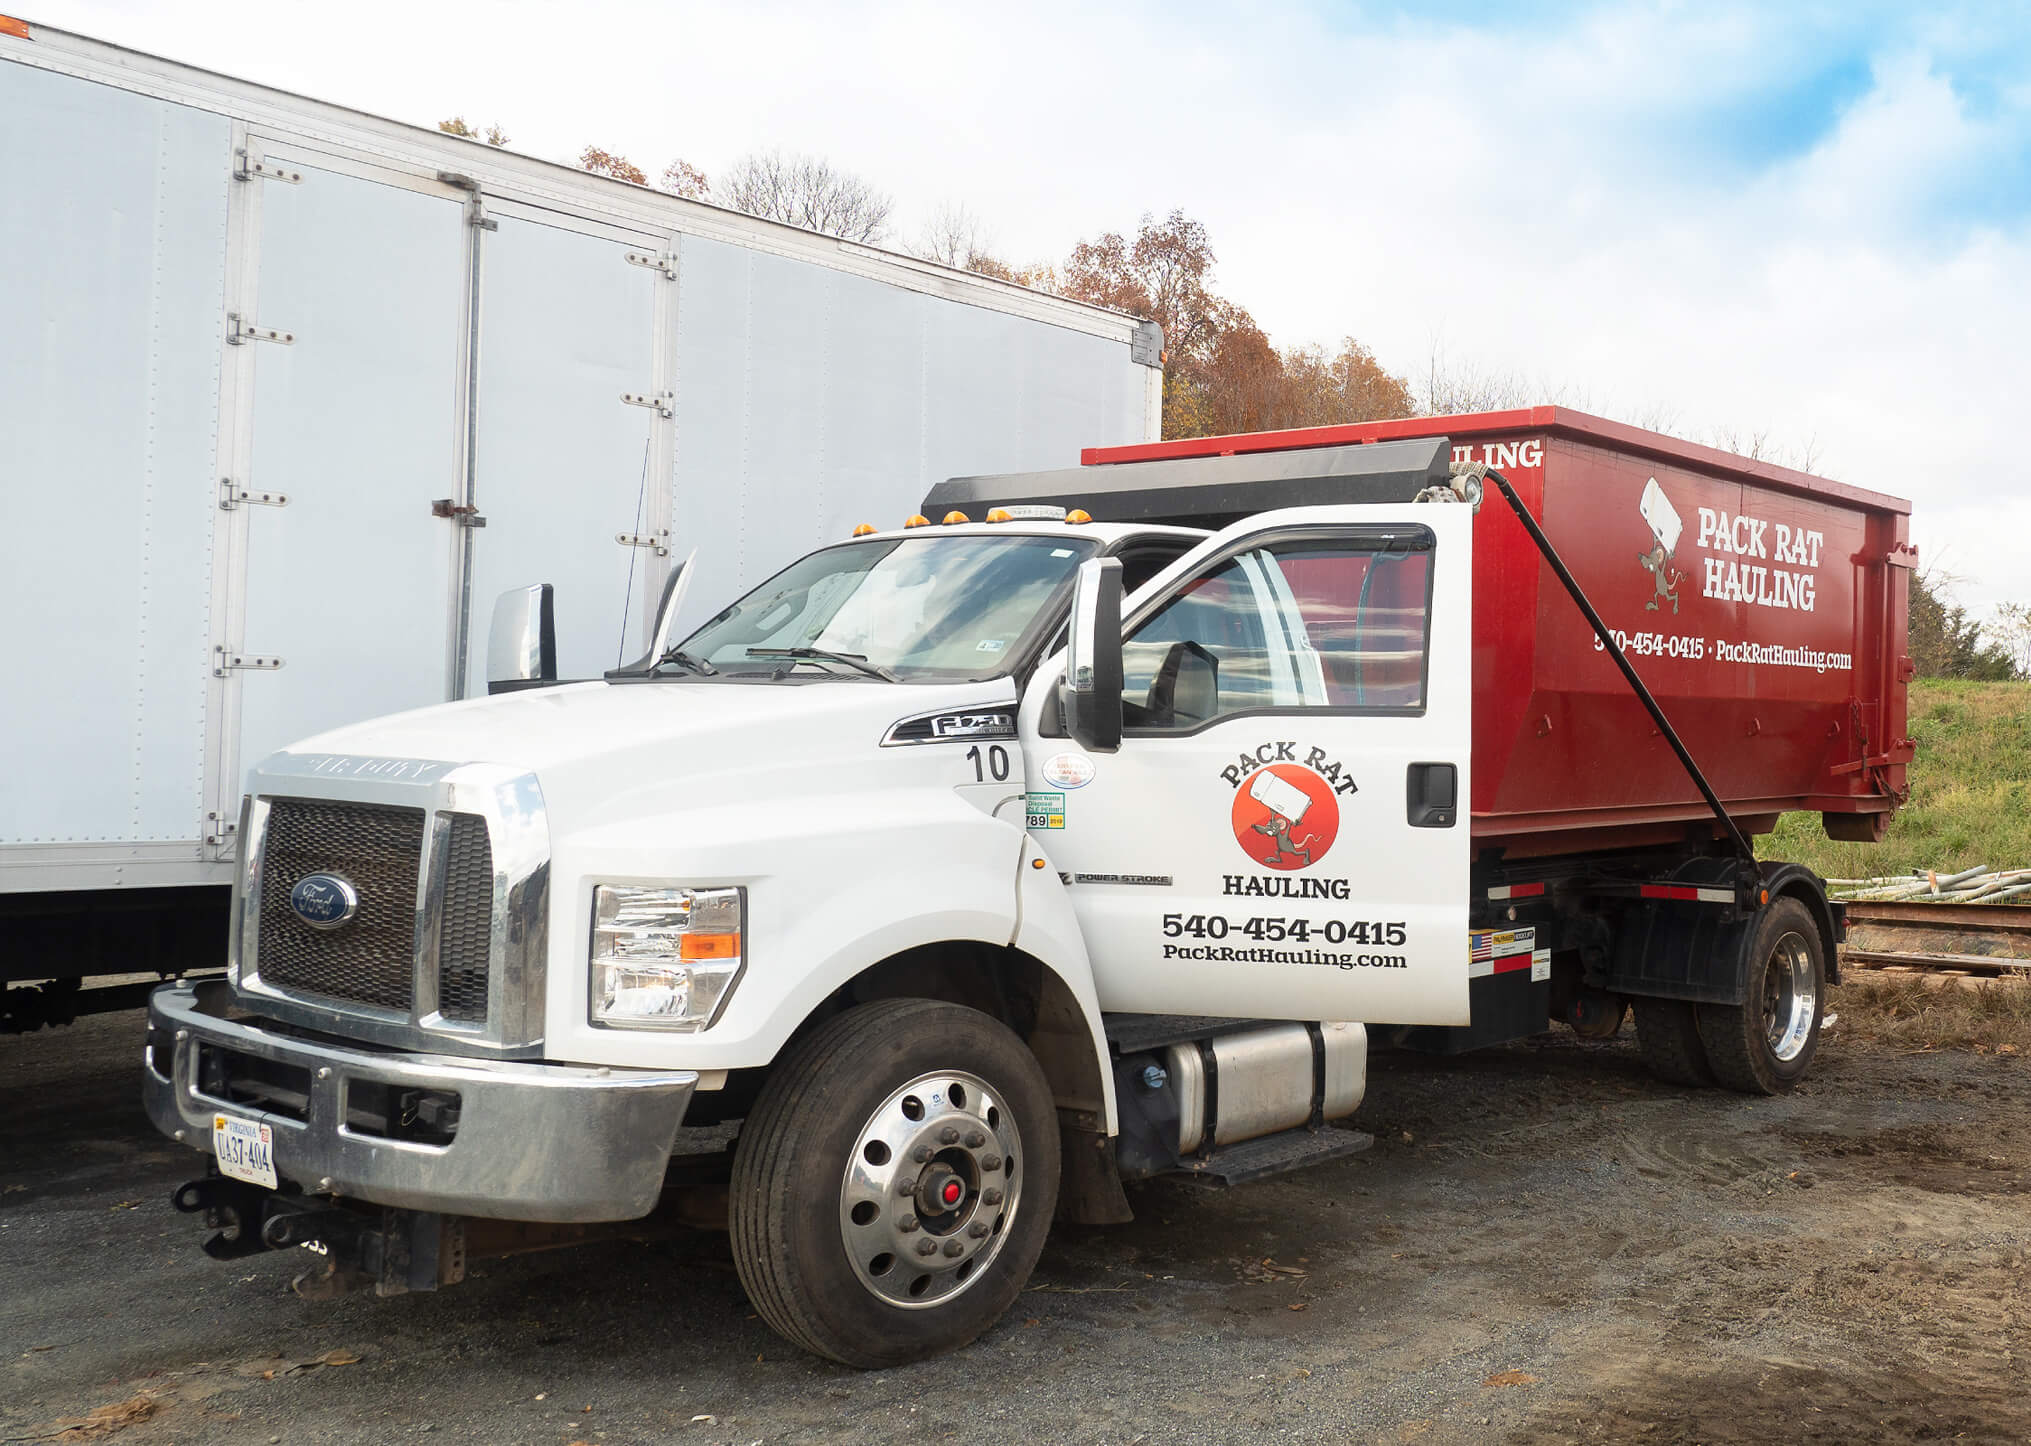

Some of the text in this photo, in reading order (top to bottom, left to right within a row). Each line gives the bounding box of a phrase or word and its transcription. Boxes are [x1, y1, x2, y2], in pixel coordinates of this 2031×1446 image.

[1697, 507, 1824, 568] PACK RAT
[1703, 557, 1816, 612] HAULING
[1716, 639, 1853, 674] PackRatHauling.com
[966, 745, 1010, 782] 10
[1220, 741, 1359, 796] PACK RAT
[1078, 874, 1169, 883] POWER STROKE
[1222, 875, 1351, 900] HAULING
[299, 883, 335, 915] Ford
[1163, 913, 1407, 946] 540-454-0415
[1163, 944, 1408, 970] PackRatHauling.com
